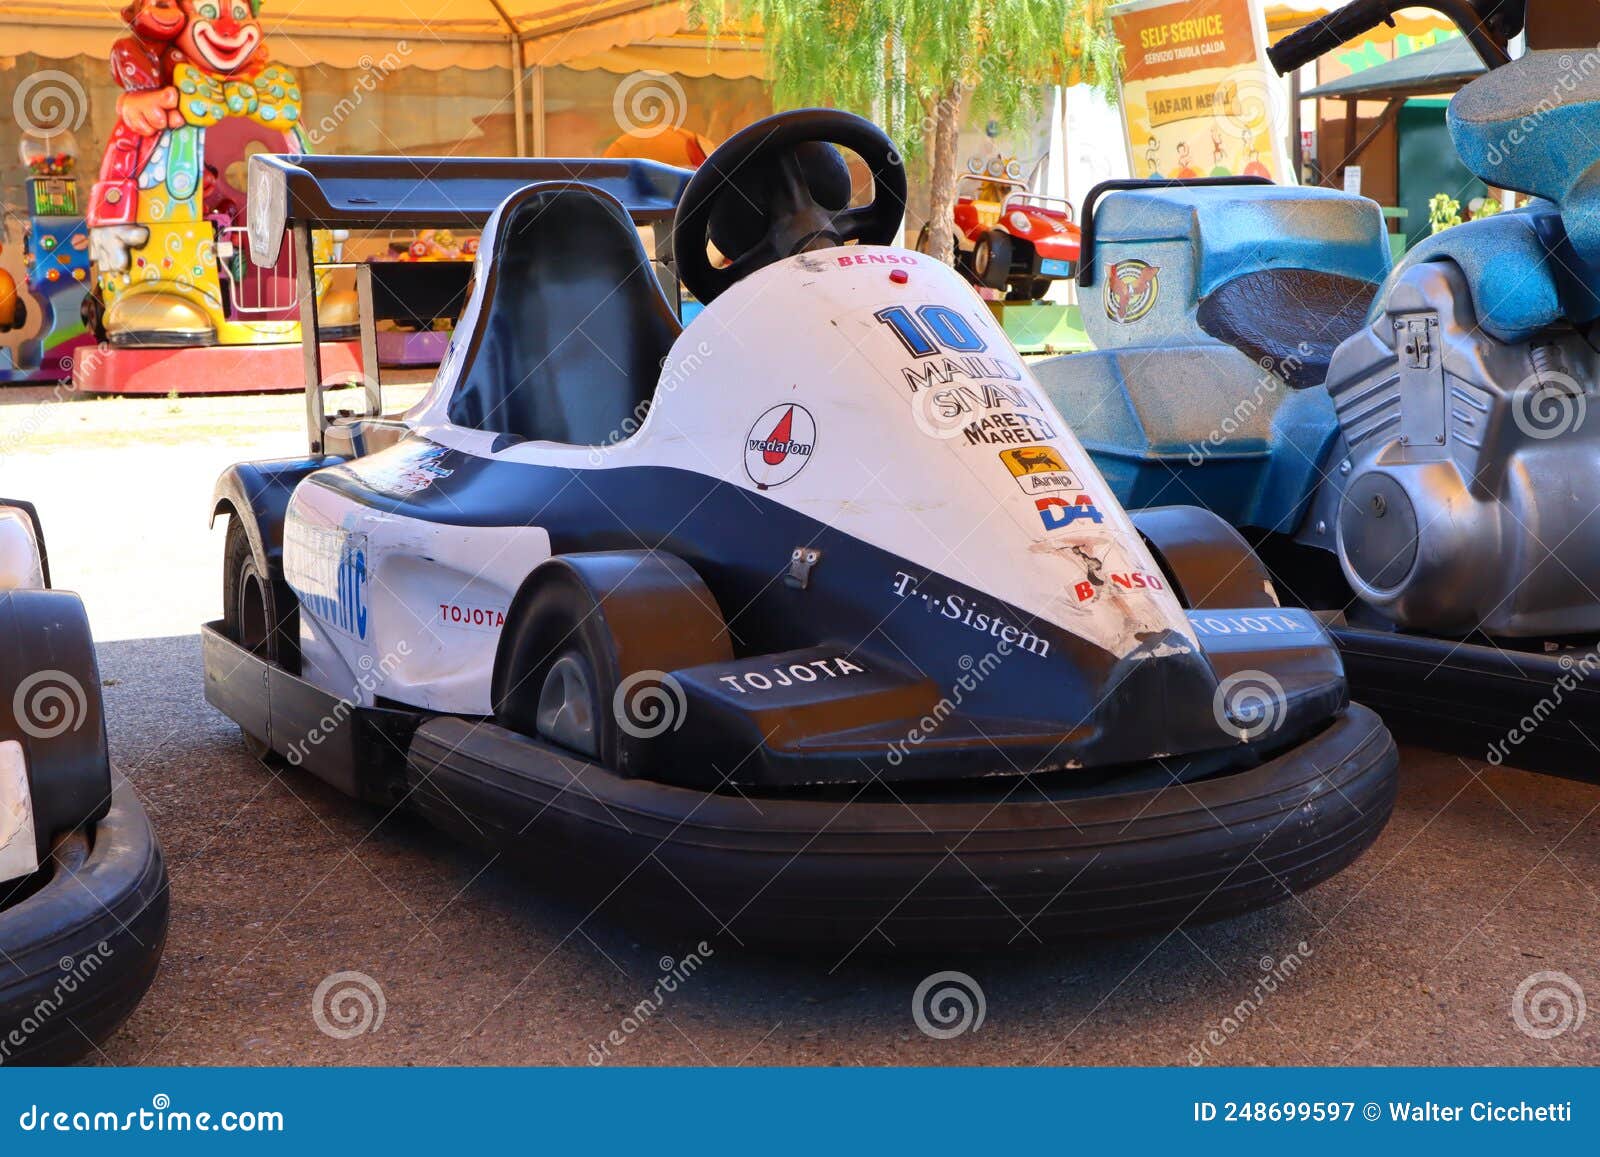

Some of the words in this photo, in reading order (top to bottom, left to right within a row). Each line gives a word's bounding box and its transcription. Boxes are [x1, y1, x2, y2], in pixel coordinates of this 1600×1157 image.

[1140, 25, 1168, 49] SELF
[1170, 14, 1224, 43] SERVICE
[837, 254, 918, 267] BENSO
[873, 304, 988, 359] 10
[749, 438, 811, 455] vedafon
[1074, 572, 1164, 602] BNSO
[440, 605, 505, 627] TOJOTA
[1189, 615, 1305, 634] TOJOTA
[719, 657, 865, 693] TOJOTA
